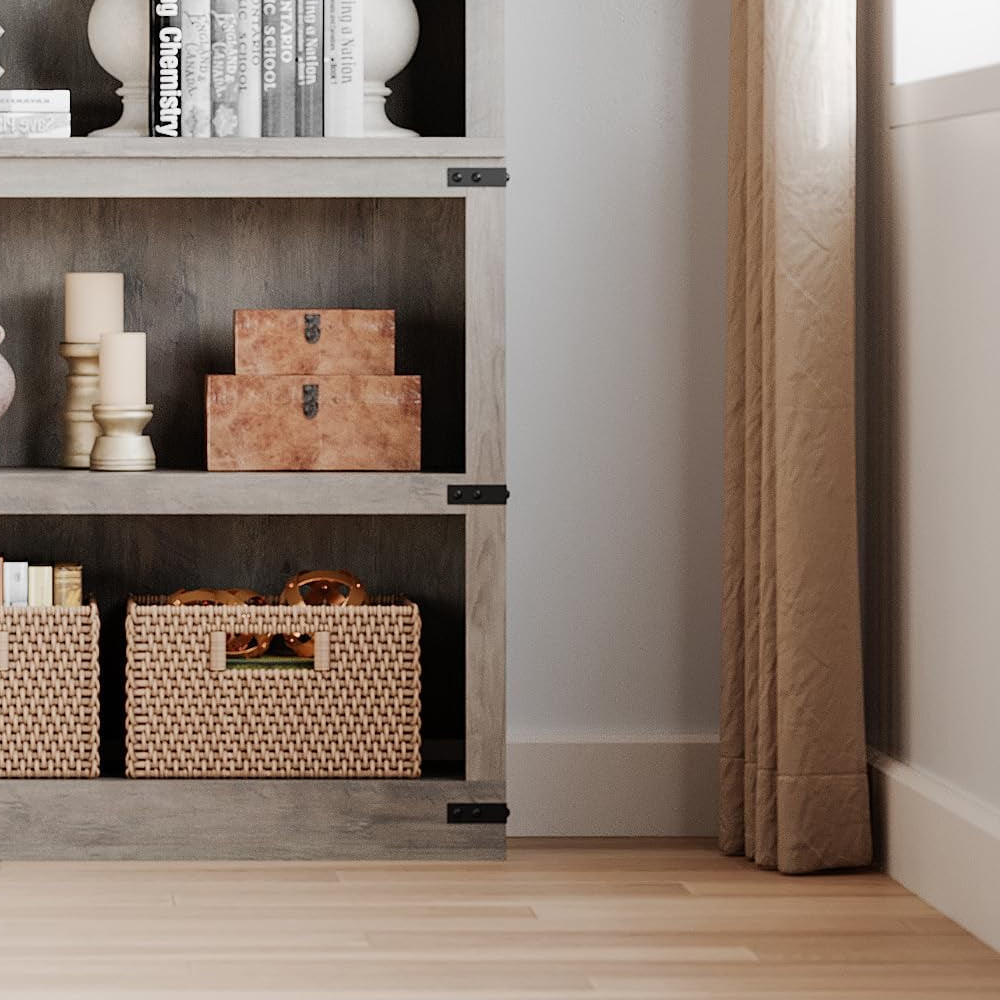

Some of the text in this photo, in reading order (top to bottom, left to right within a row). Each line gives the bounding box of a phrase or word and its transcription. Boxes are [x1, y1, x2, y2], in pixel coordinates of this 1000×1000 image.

[305, 26, 316, 36] a
[341, 26, 351, 35] a
[156, 27, 182, 138] Chemistry
[239, 31, 248, 93] SCHOOL
[263, 25, 277, 92] SCHOOL
[305, 37, 319, 85] Nation
[340, 37, 355, 84] Nation
